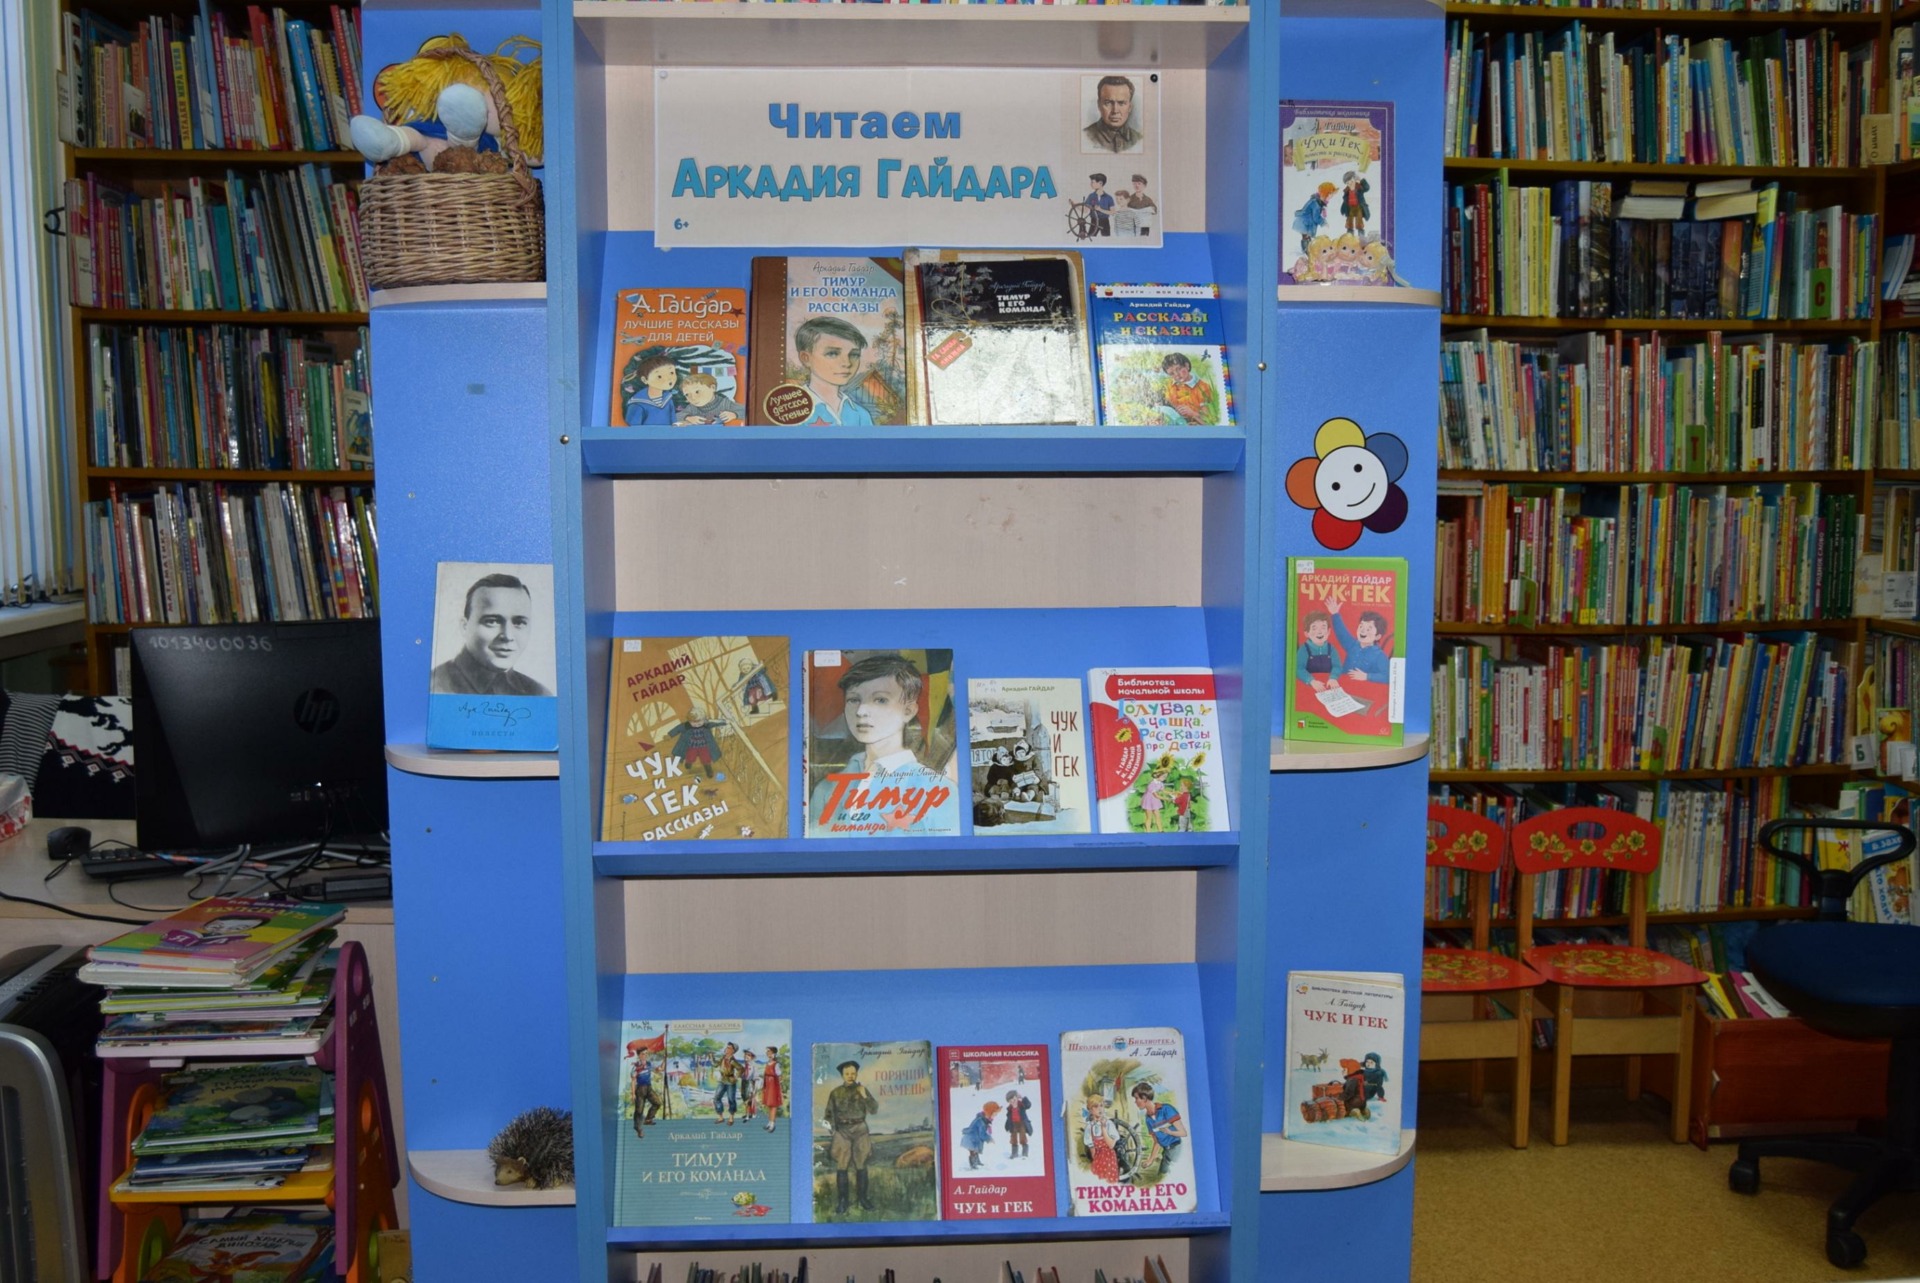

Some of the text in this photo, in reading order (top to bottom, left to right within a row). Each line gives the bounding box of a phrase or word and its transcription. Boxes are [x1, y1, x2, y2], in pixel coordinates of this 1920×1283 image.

[769, 102, 961, 139] Читаем
[673, 218, 690, 231] 6+
[822, 277, 866, 287] ТИМУР
[790, 287, 897, 298] И ЕГО КОМАНДА
[996, 293, 1031, 301] ТИМУР
[631, 294, 733, 318] А. Гайдар
[808, 302, 879, 313] РАССКАЗЫ
[999, 306, 1046, 314] КОМАНДА
[1113, 312, 1208, 322] РАССКАЗЫ
[624, 319, 739, 330] ЛУЧШИЕ РАССКАЗЫ
[1135, 326, 1204, 336] СКАЗКИ
[647, 331, 714, 343] ДЛЯ ДЕТЕЙ
[160, 528, 174, 612] МАТЕМАТИКА
[1301, 574, 1392, 585] АРКАДИЙ ГАЙДАР
[1300, 583, 1347, 602] ЧУК
[1351, 584, 1391, 603] ГЕК
[626, 653, 692, 688] АРКАДИЙ
[632, 674, 686, 702] ГАЙДАР
[1118, 678, 1175, 687] Библиотека
[1118, 687, 1205, 696] начальной школы
[299, 689, 334, 734] hp
[1117, 698, 1194, 720] Голубая
[1051, 710, 1078, 731] ЧУК
[1053, 734, 1062, 753] И
[1856, 744, 1865, 761] Б
[626, 751, 683, 780] ЧУК
[1054, 755, 1080, 777] ГЕК
[643, 783, 700, 816] ГЕК
[818, 772, 950, 826] Тимур
[642, 800, 729, 841] РАССКАЗЫ
[837, 813, 871, 822] и его
[831, 822, 886, 836] команда
[1304, 1009, 1388, 1029] ЧУК И ГЕК
[1144, 1047, 1177, 1059] Гайдар
[875, 1067, 925, 1082] ГОРЯЧИЙ
[879, 1083, 926, 1097] КАМЕНЬ
[668, 1131, 743, 1141] Аркадий Гайдар
[672, 1152, 738, 1168] ТИМУР
[642, 1169, 767, 1183] И ЕГО КОМАНДА
[953, 1184, 1008, 1197] А. Гайдар
[1076, 1185, 1135, 1200] ТИМУР
[1155, 1183, 1188, 1196] ЕГО
[954, 1202, 987, 1214] ЧУК
[1004, 1201, 1034, 1213] ГЕК
[1089, 1198, 1177, 1214] КОМАНДА
